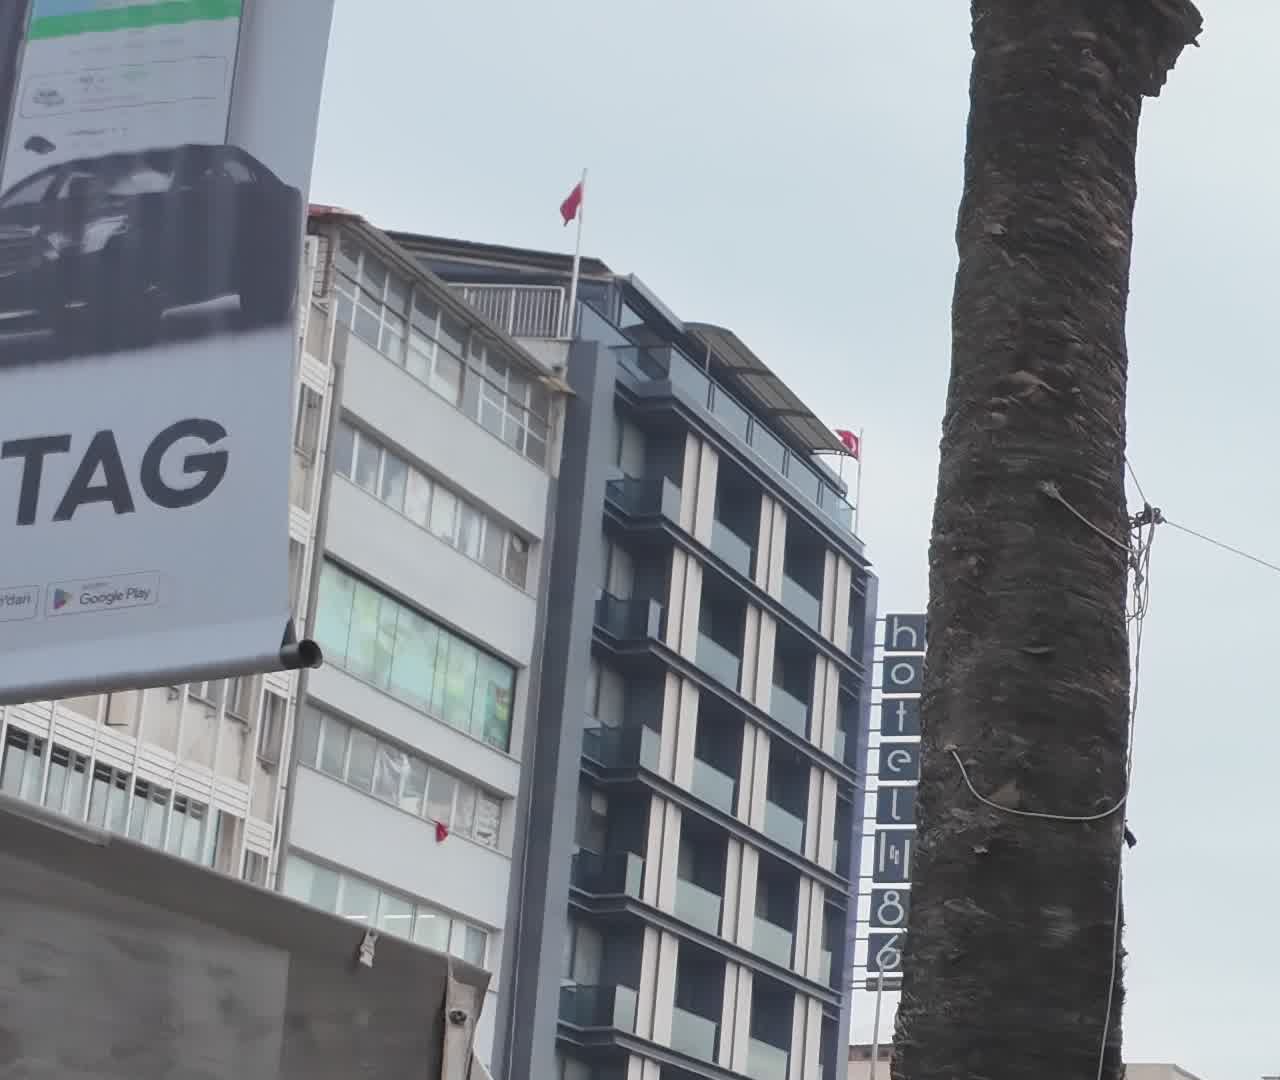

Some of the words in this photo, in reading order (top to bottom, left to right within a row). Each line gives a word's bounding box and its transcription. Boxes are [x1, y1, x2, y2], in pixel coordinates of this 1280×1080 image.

[0, 417, 229, 526] TAG
[79, 589, 123, 605] Google
[126, 586, 151, 600] Play
[887, 615, 917, 821] hotel
